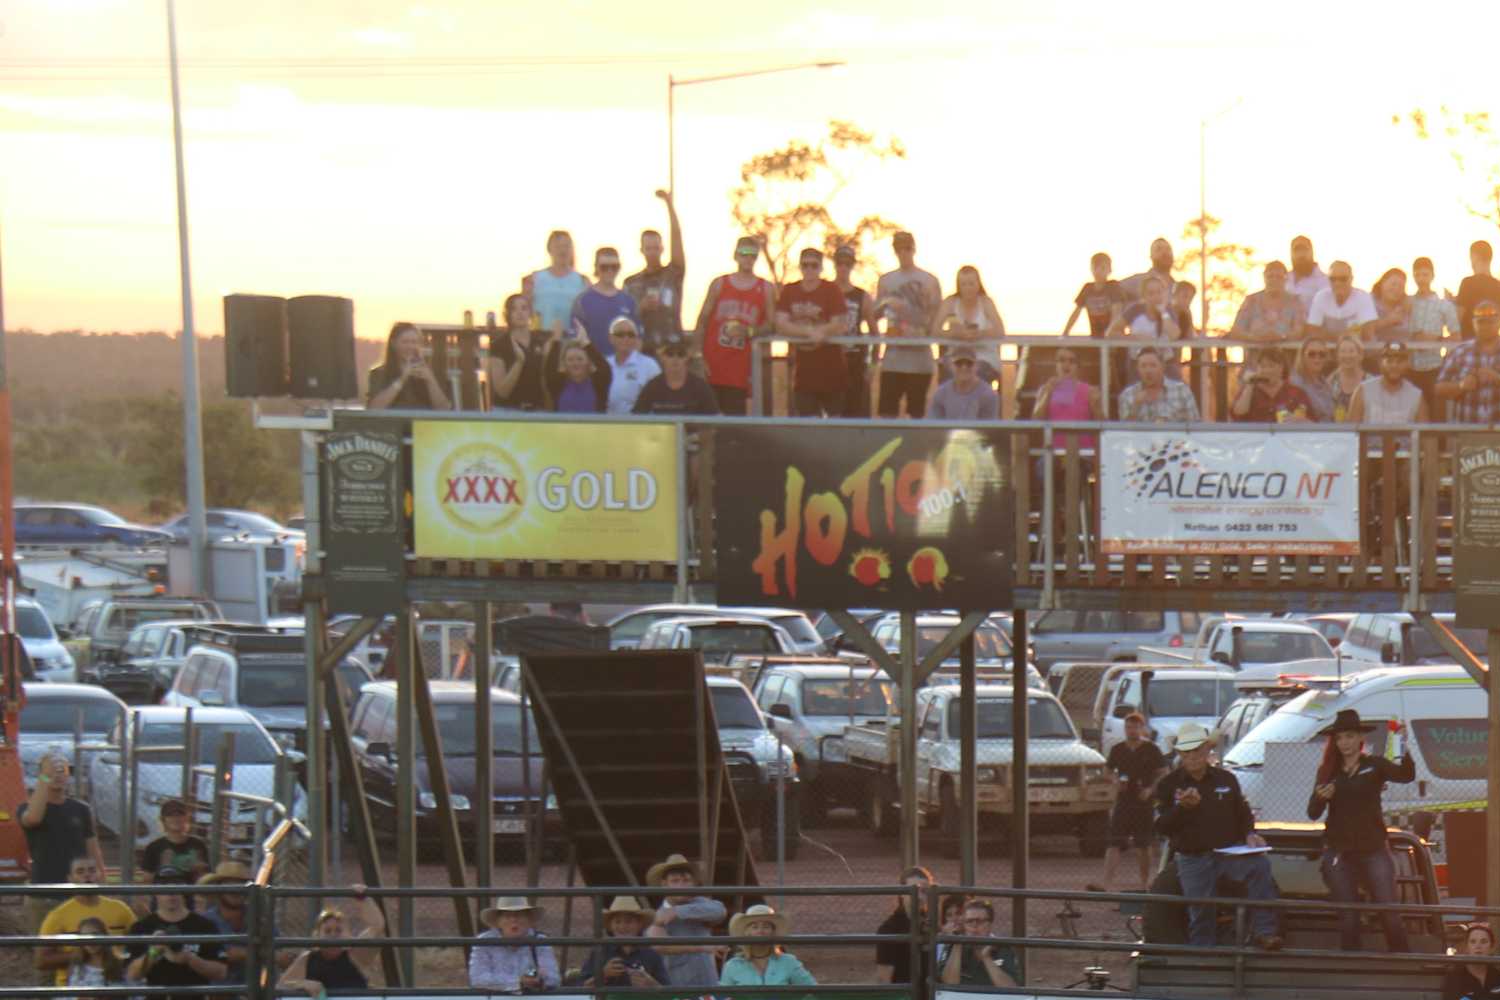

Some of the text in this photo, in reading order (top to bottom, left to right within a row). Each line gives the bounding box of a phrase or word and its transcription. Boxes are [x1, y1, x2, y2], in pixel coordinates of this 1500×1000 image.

[1460, 452, 1486, 475] JACK
[442, 475, 523, 505] XXXX
[536, 466, 659, 513] GOLD
[1149, 472, 1341, 499] ALENCO NT
